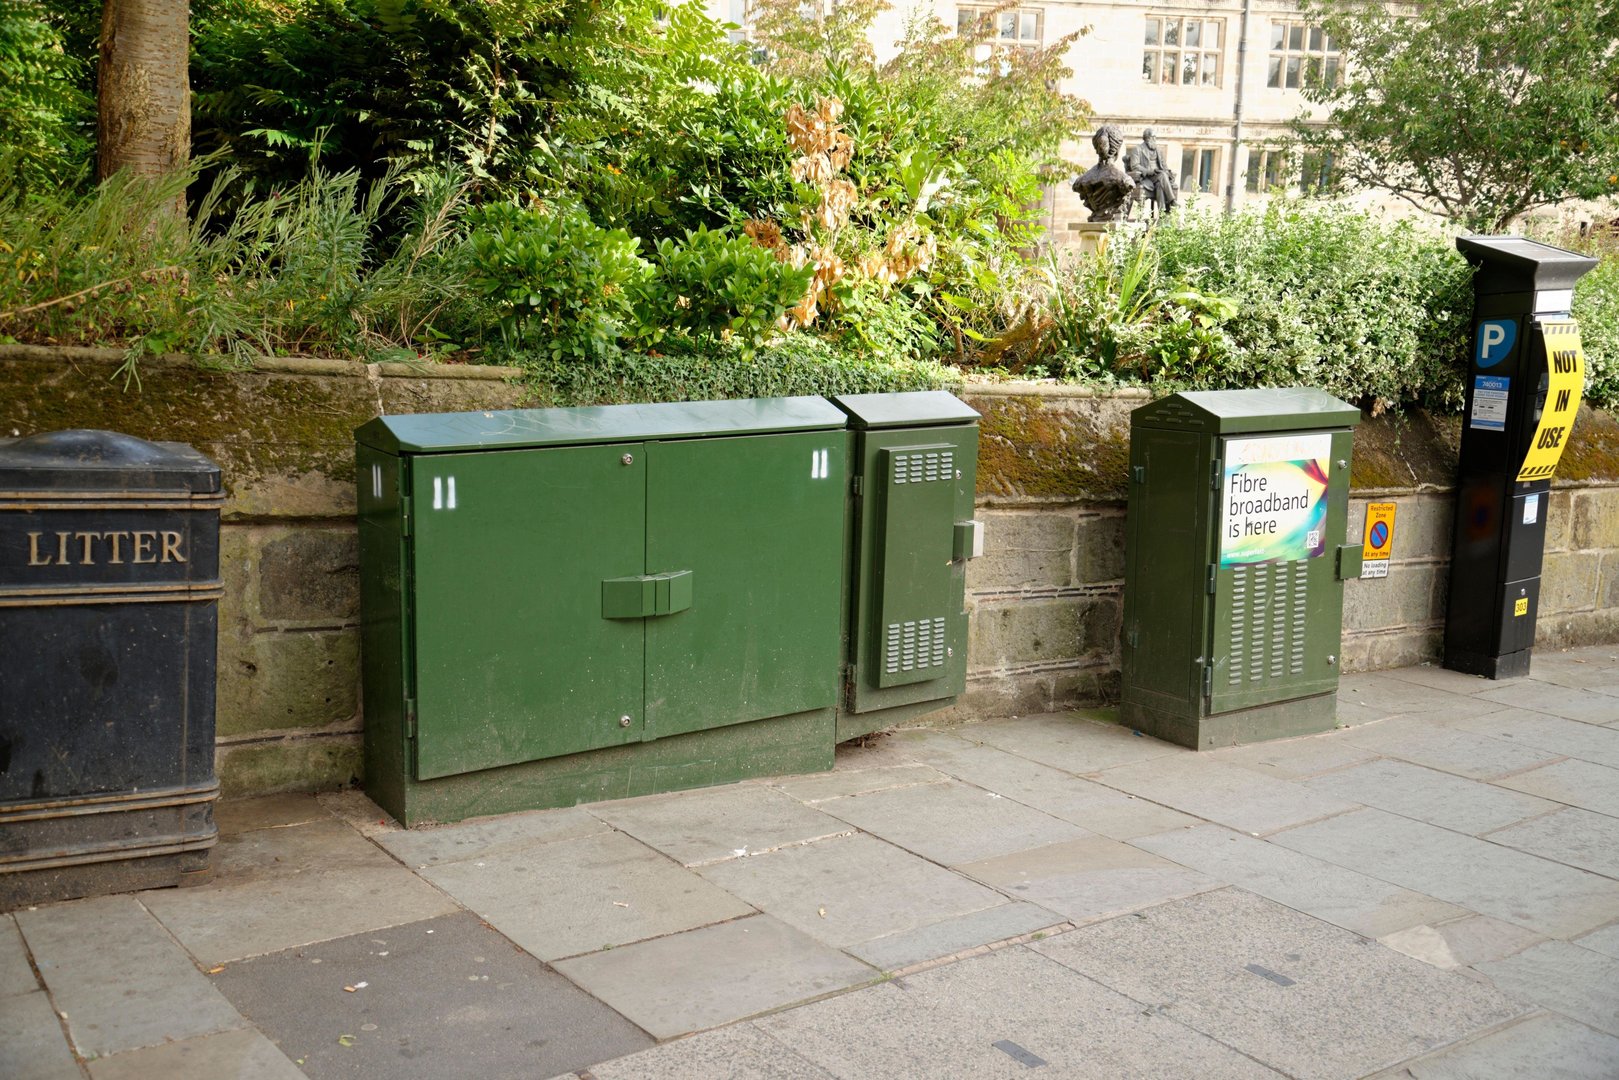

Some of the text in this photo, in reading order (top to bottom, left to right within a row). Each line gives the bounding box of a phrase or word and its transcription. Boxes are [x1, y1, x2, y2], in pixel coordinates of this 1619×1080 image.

[1481, 323, 1506, 359] P
[1553, 350, 1577, 374] NOT
[1555, 390, 1571, 413] IN
[1537, 426, 1566, 450] USE
[1231, 473, 1268, 494] Fibre
[1229, 489, 1309, 516] broadband
[1228, 517, 1277, 538] is here
[27, 531, 188, 566] LITTER
[1516, 602, 1526, 612] 303
